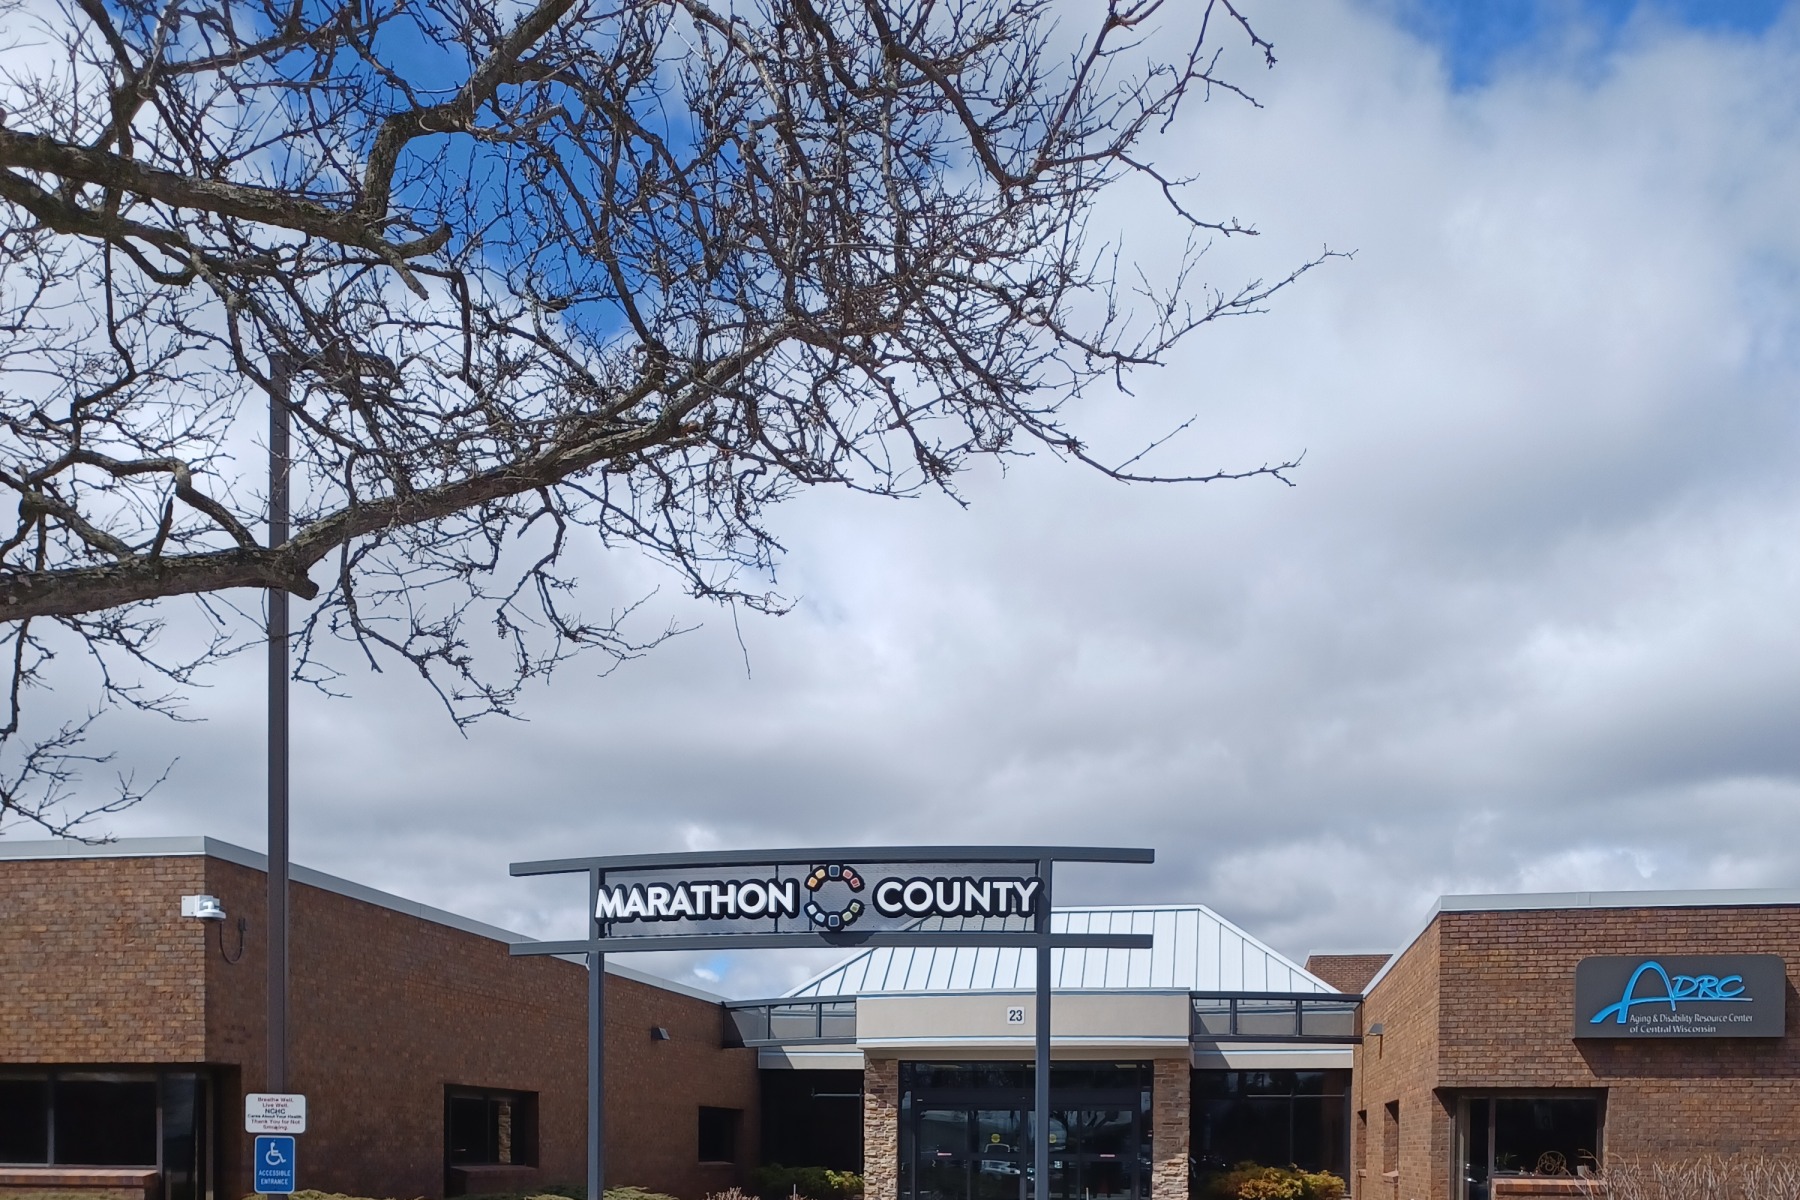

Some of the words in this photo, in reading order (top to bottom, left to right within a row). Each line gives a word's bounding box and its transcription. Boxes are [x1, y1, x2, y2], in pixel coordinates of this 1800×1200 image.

[595, 882, 795, 918] MARATHON
[877, 880, 1039, 912] COUNTY
[1590, 961, 1753, 1024] ADRC
[1009, 1009, 1023, 1022] 23
[1630, 1014, 1651, 1024] Aging
[1652, 1014, 1659, 1022] &
[1660, 1014, 1692, 1024] Disability
[1694, 1014, 1728, 1022] Resource
[1728, 1013, 1753, 1022] Center
[1630, 1025, 1639, 1033] of
[1640, 1025, 1671, 1033] Central
[1673, 1025, 1717, 1033] Wisconsin
[258, 1169, 291, 1177] ACCESSIBLE
